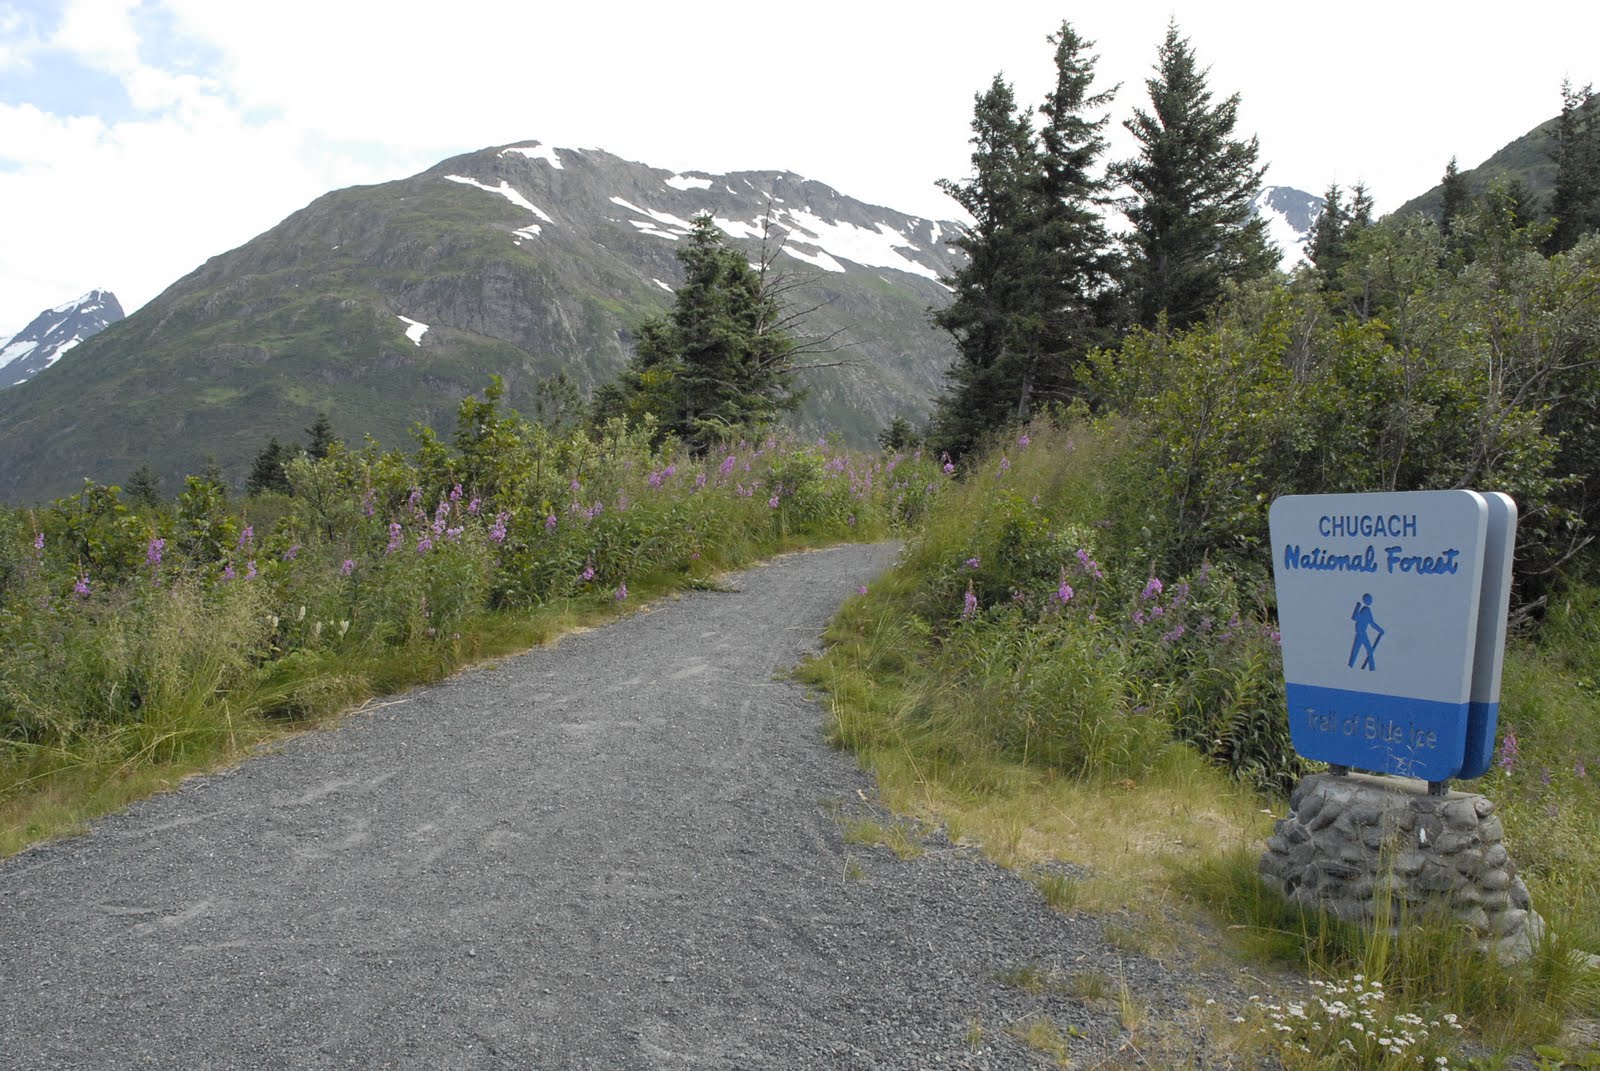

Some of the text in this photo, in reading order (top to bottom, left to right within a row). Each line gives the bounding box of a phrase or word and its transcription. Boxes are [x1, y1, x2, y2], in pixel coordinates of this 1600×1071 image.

[1319, 515, 1417, 537] CHUGACH
[1285, 544, 1460, 575] National Forest
[1305, 707, 1337, 733] Trail
[1343, 714, 1360, 736] of
[1364, 715, 1403, 743] Blue
